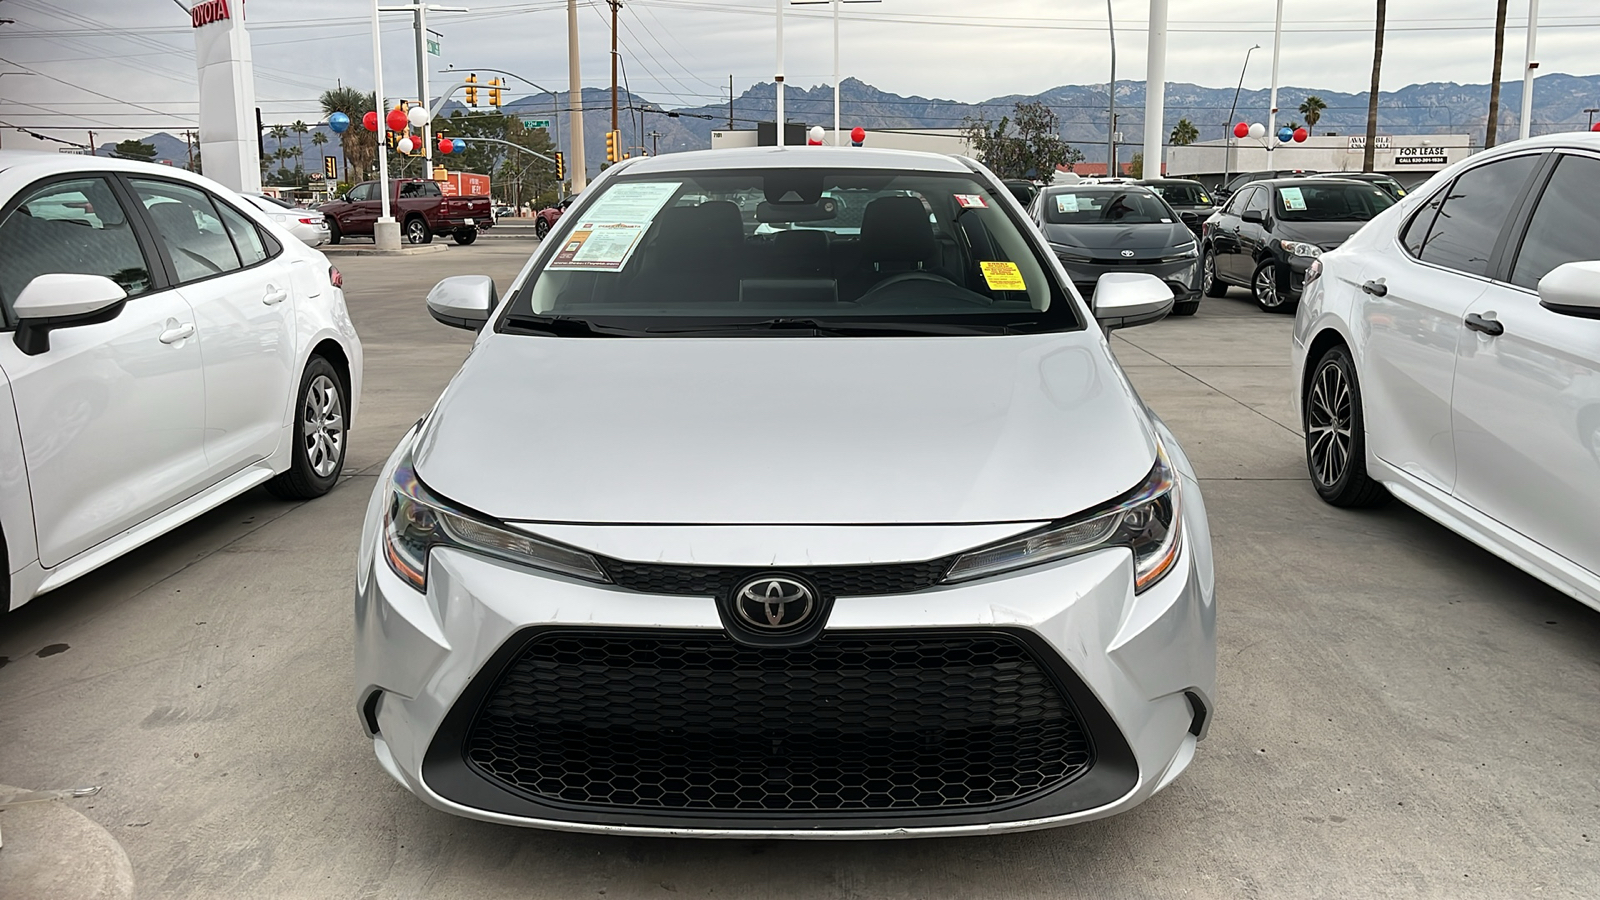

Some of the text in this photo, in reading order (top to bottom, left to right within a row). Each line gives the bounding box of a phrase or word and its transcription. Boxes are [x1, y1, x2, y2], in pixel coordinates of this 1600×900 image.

[191, 0, 230, 28] OYOTA
[1399, 147, 1444, 156] FOR LEASE
